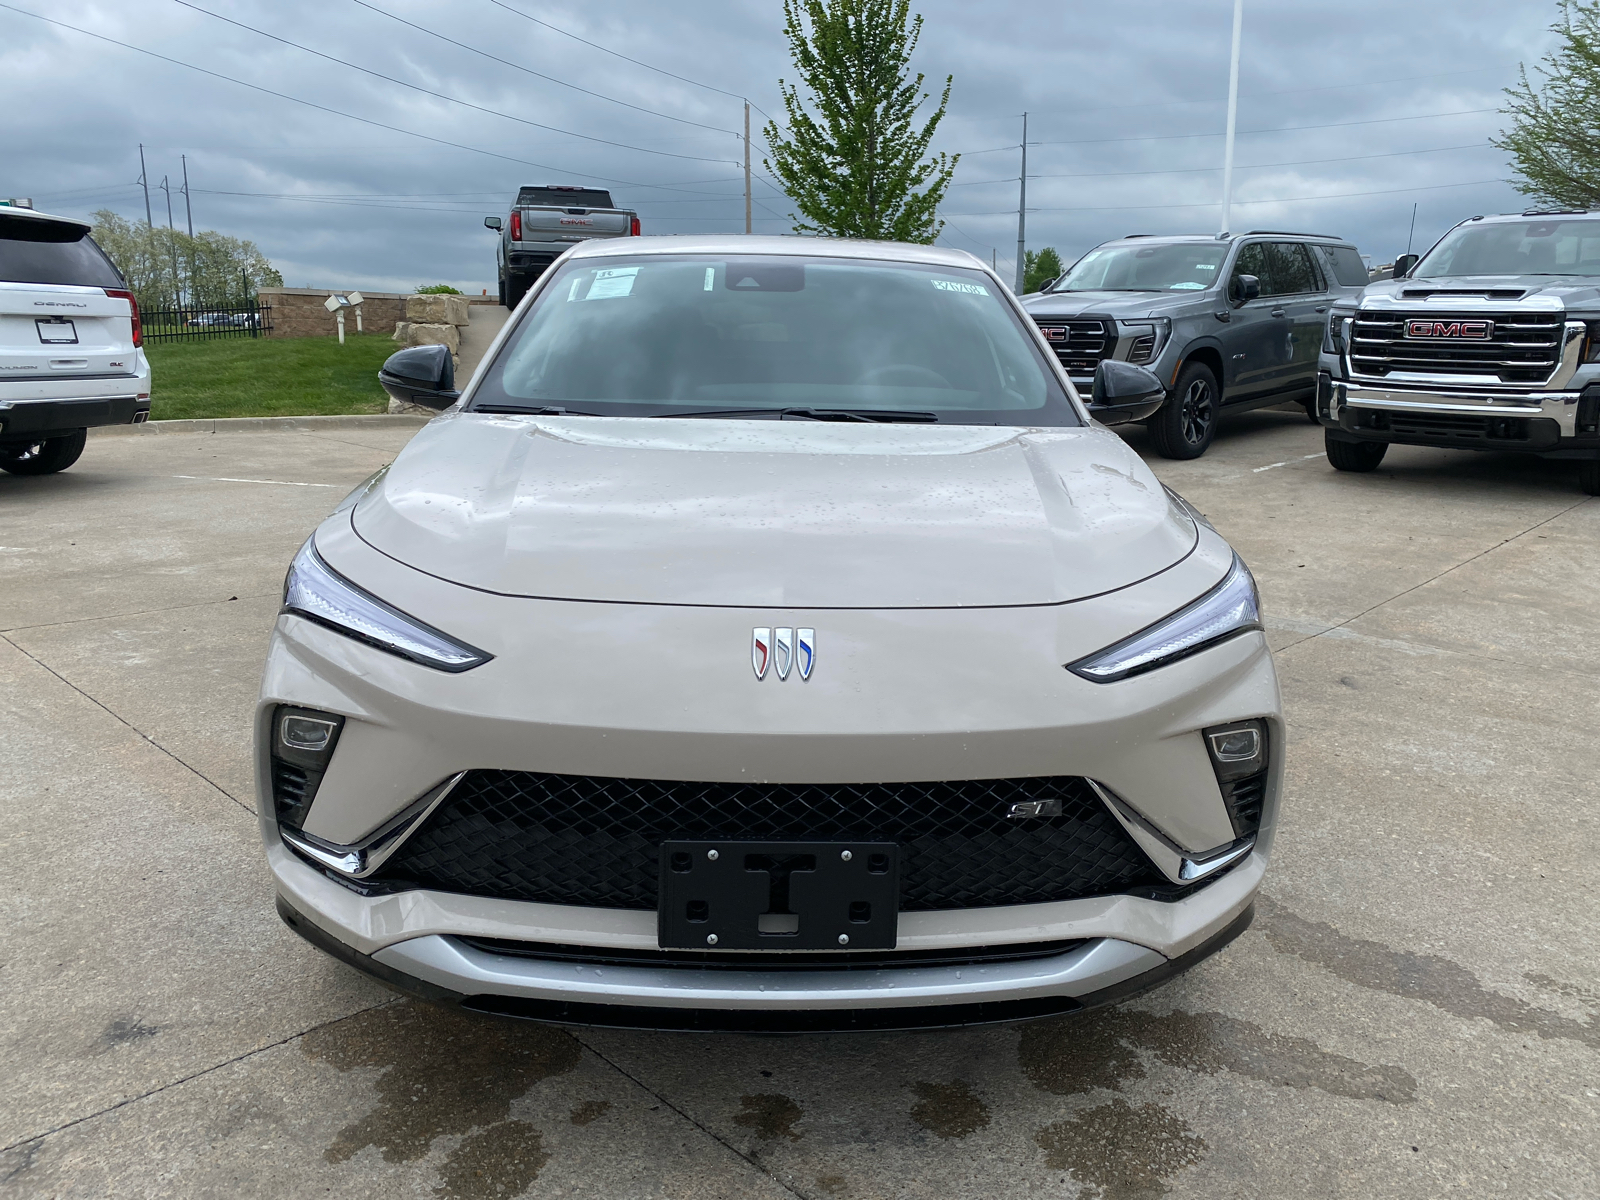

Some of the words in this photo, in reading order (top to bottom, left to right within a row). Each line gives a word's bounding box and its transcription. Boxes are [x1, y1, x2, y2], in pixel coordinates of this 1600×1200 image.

[560, 217, 594, 226] GMC
[1409, 321, 1487, 337] GMC
[1006, 799, 1055, 819] ST
